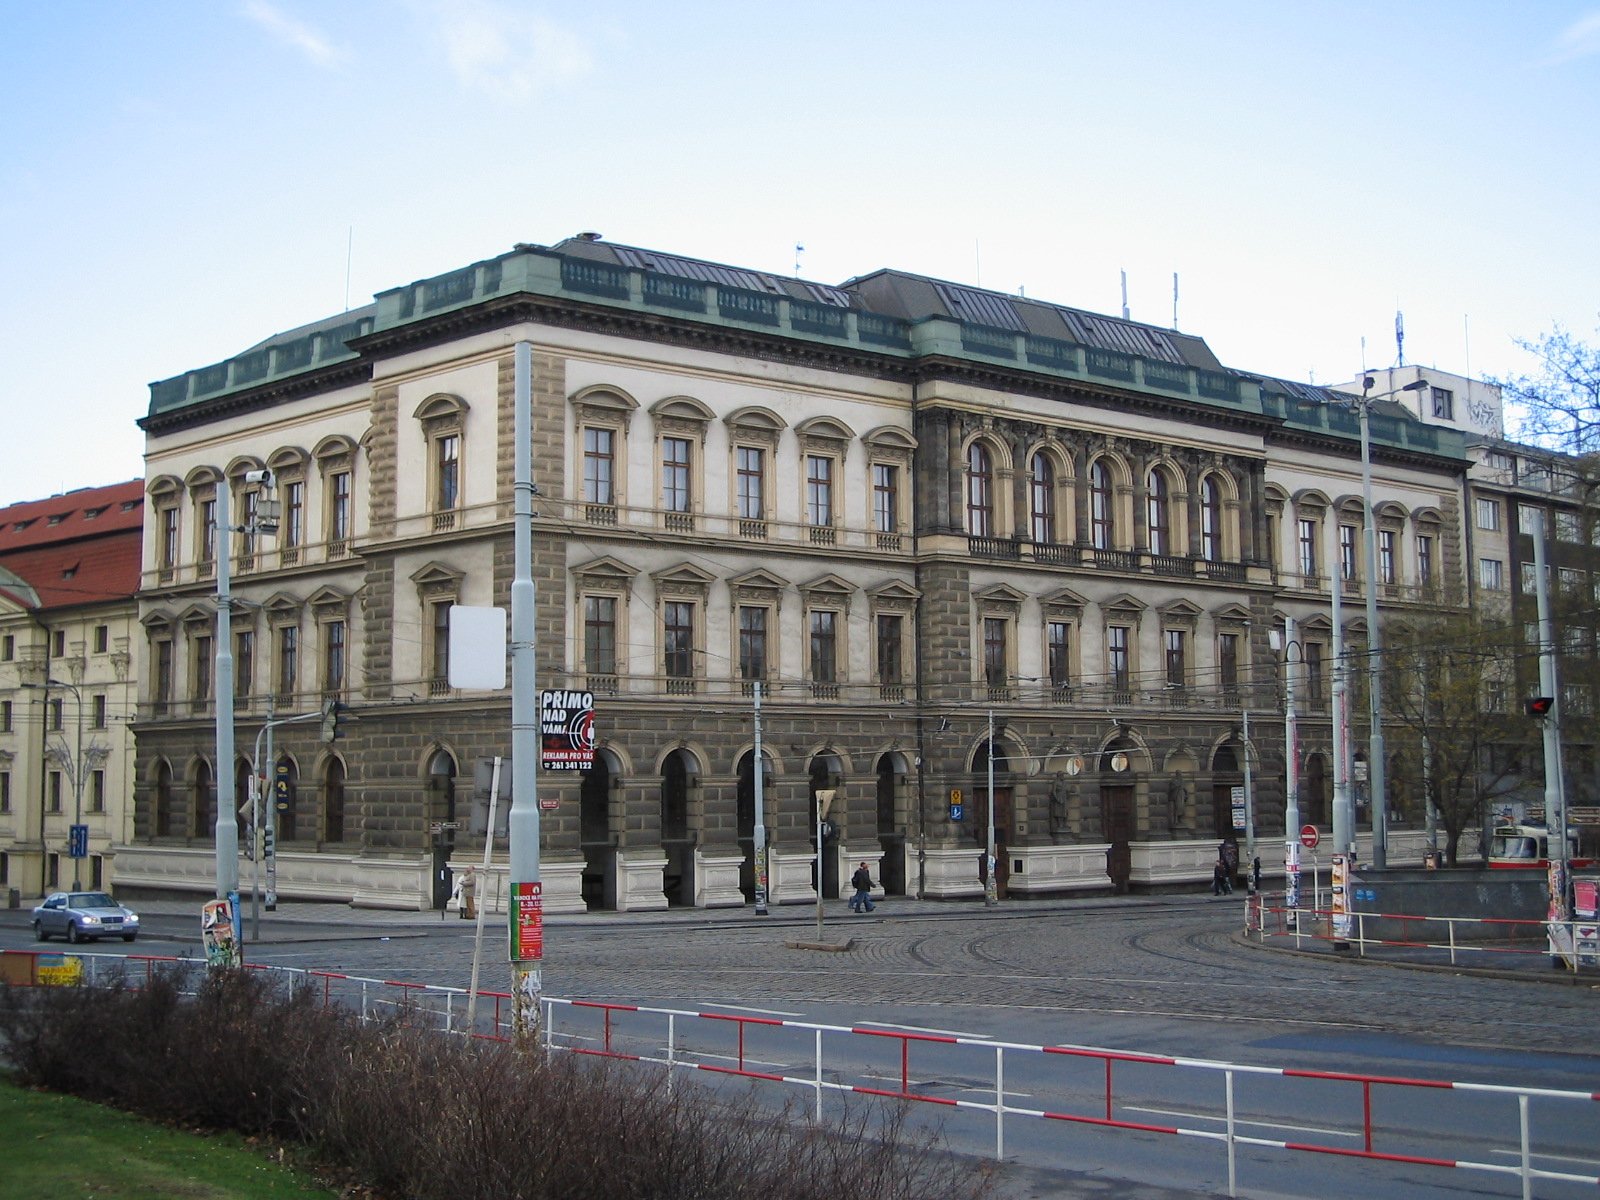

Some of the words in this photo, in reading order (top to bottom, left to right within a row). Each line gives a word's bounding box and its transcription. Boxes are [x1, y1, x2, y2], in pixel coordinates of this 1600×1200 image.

[543, 691, 592, 709] PŘÍMO
[543, 710, 567, 722] NAD
[542, 752, 568, 760] REKLAMA
[569, 752, 582, 760] PRO
[583, 751, 593, 760] VÁS
[551, 762, 564, 770] 261
[565, 762, 578, 770] 341
[579, 762, 592, 770] 122
